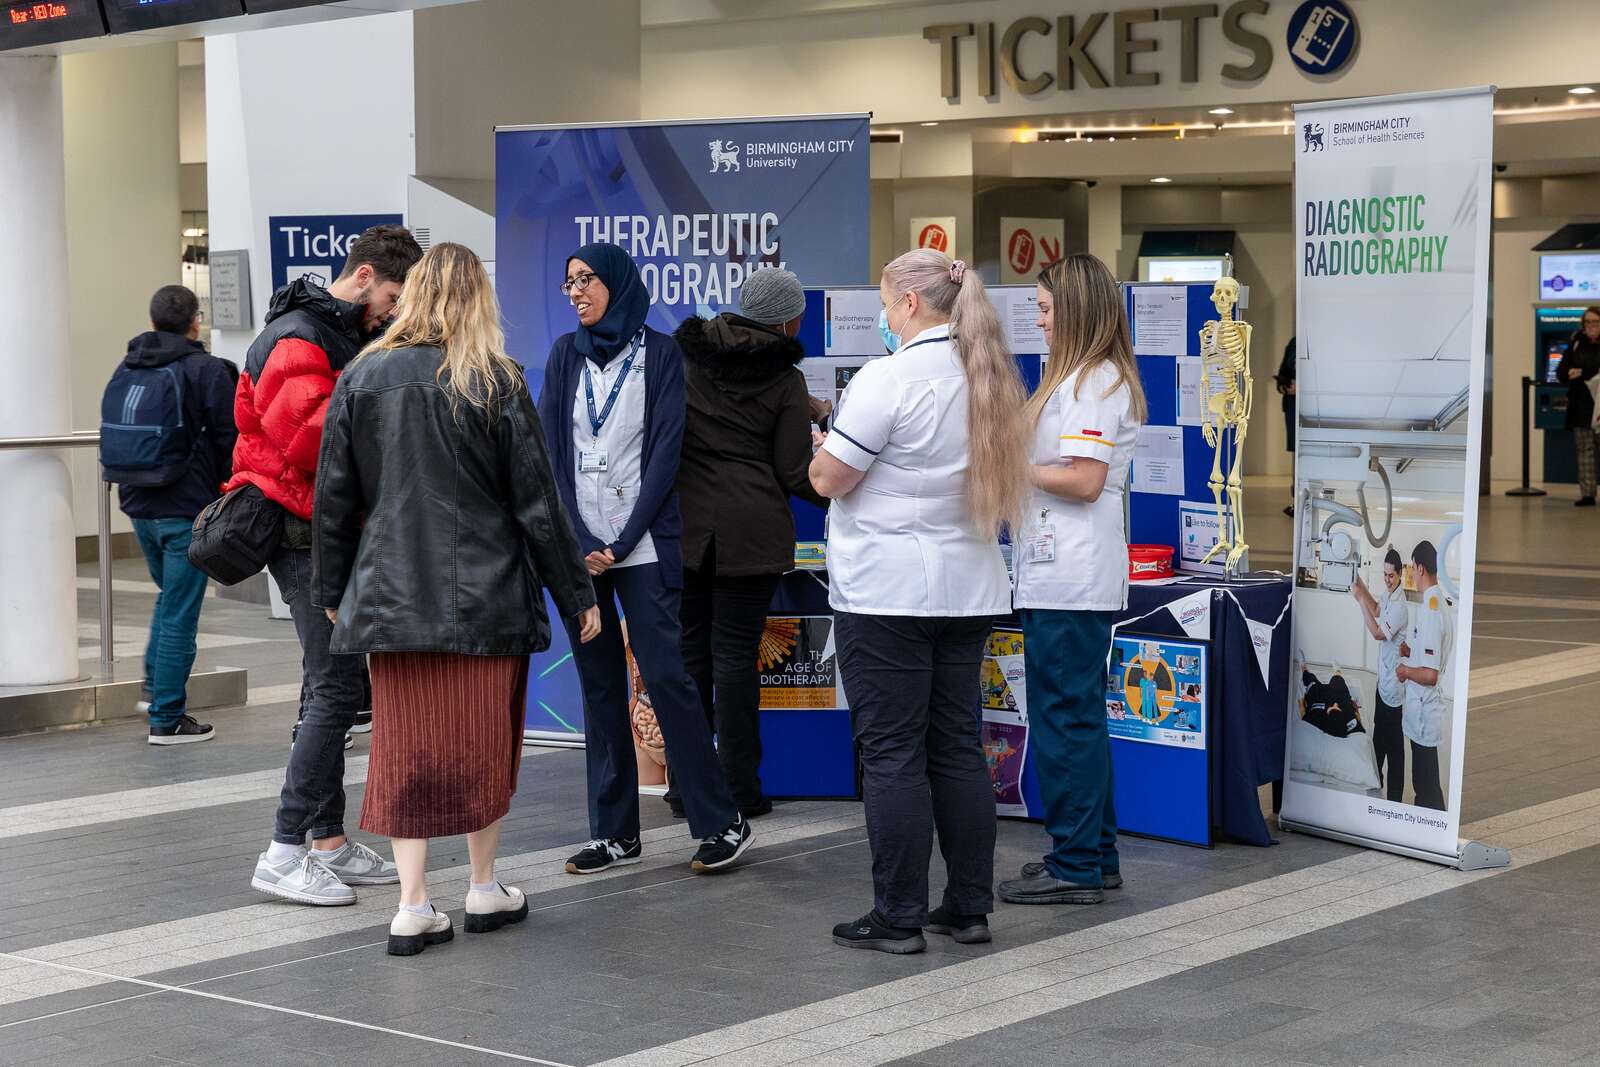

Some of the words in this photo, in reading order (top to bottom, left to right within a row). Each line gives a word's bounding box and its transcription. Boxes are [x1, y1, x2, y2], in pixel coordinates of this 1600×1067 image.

[10, 9, 28, 23] Rear
[33, 4, 47, 20] RED
[49, 4, 67, 18] Zone
[923, 0, 1274, 98] TICKETS
[1334, 119, 1389, 134] BIRMINGHAM
[1391, 117, 1410, 129] CITY
[1333, 136, 1357, 146] School
[1367, 133, 1391, 143] Health
[1393, 130, 1425, 141] Sciences
[746, 141, 825, 155] BIRMINGHAM
[827, 139, 854, 153] CITY
[746, 157, 797, 168] University
[1305, 194, 1425, 237] DIAGNOSTIC
[279, 225, 361, 258] Ticke
[574, 212, 779, 257] THERAPEUTIC
[1304, 235, 1448, 277] RADIOGRAPHY
[834, 315, 874, 323] Radiotherapy
[809, 650, 824, 660] TH
[785, 662, 811, 673] AGE
[815, 662, 831, 673] OF
[760, 674, 832, 685] DIOTHERAPY
[1368, 805, 1404, 819] Birmingham
[1405, 812, 1417, 825] City
[1417, 816, 1448, 830] University
